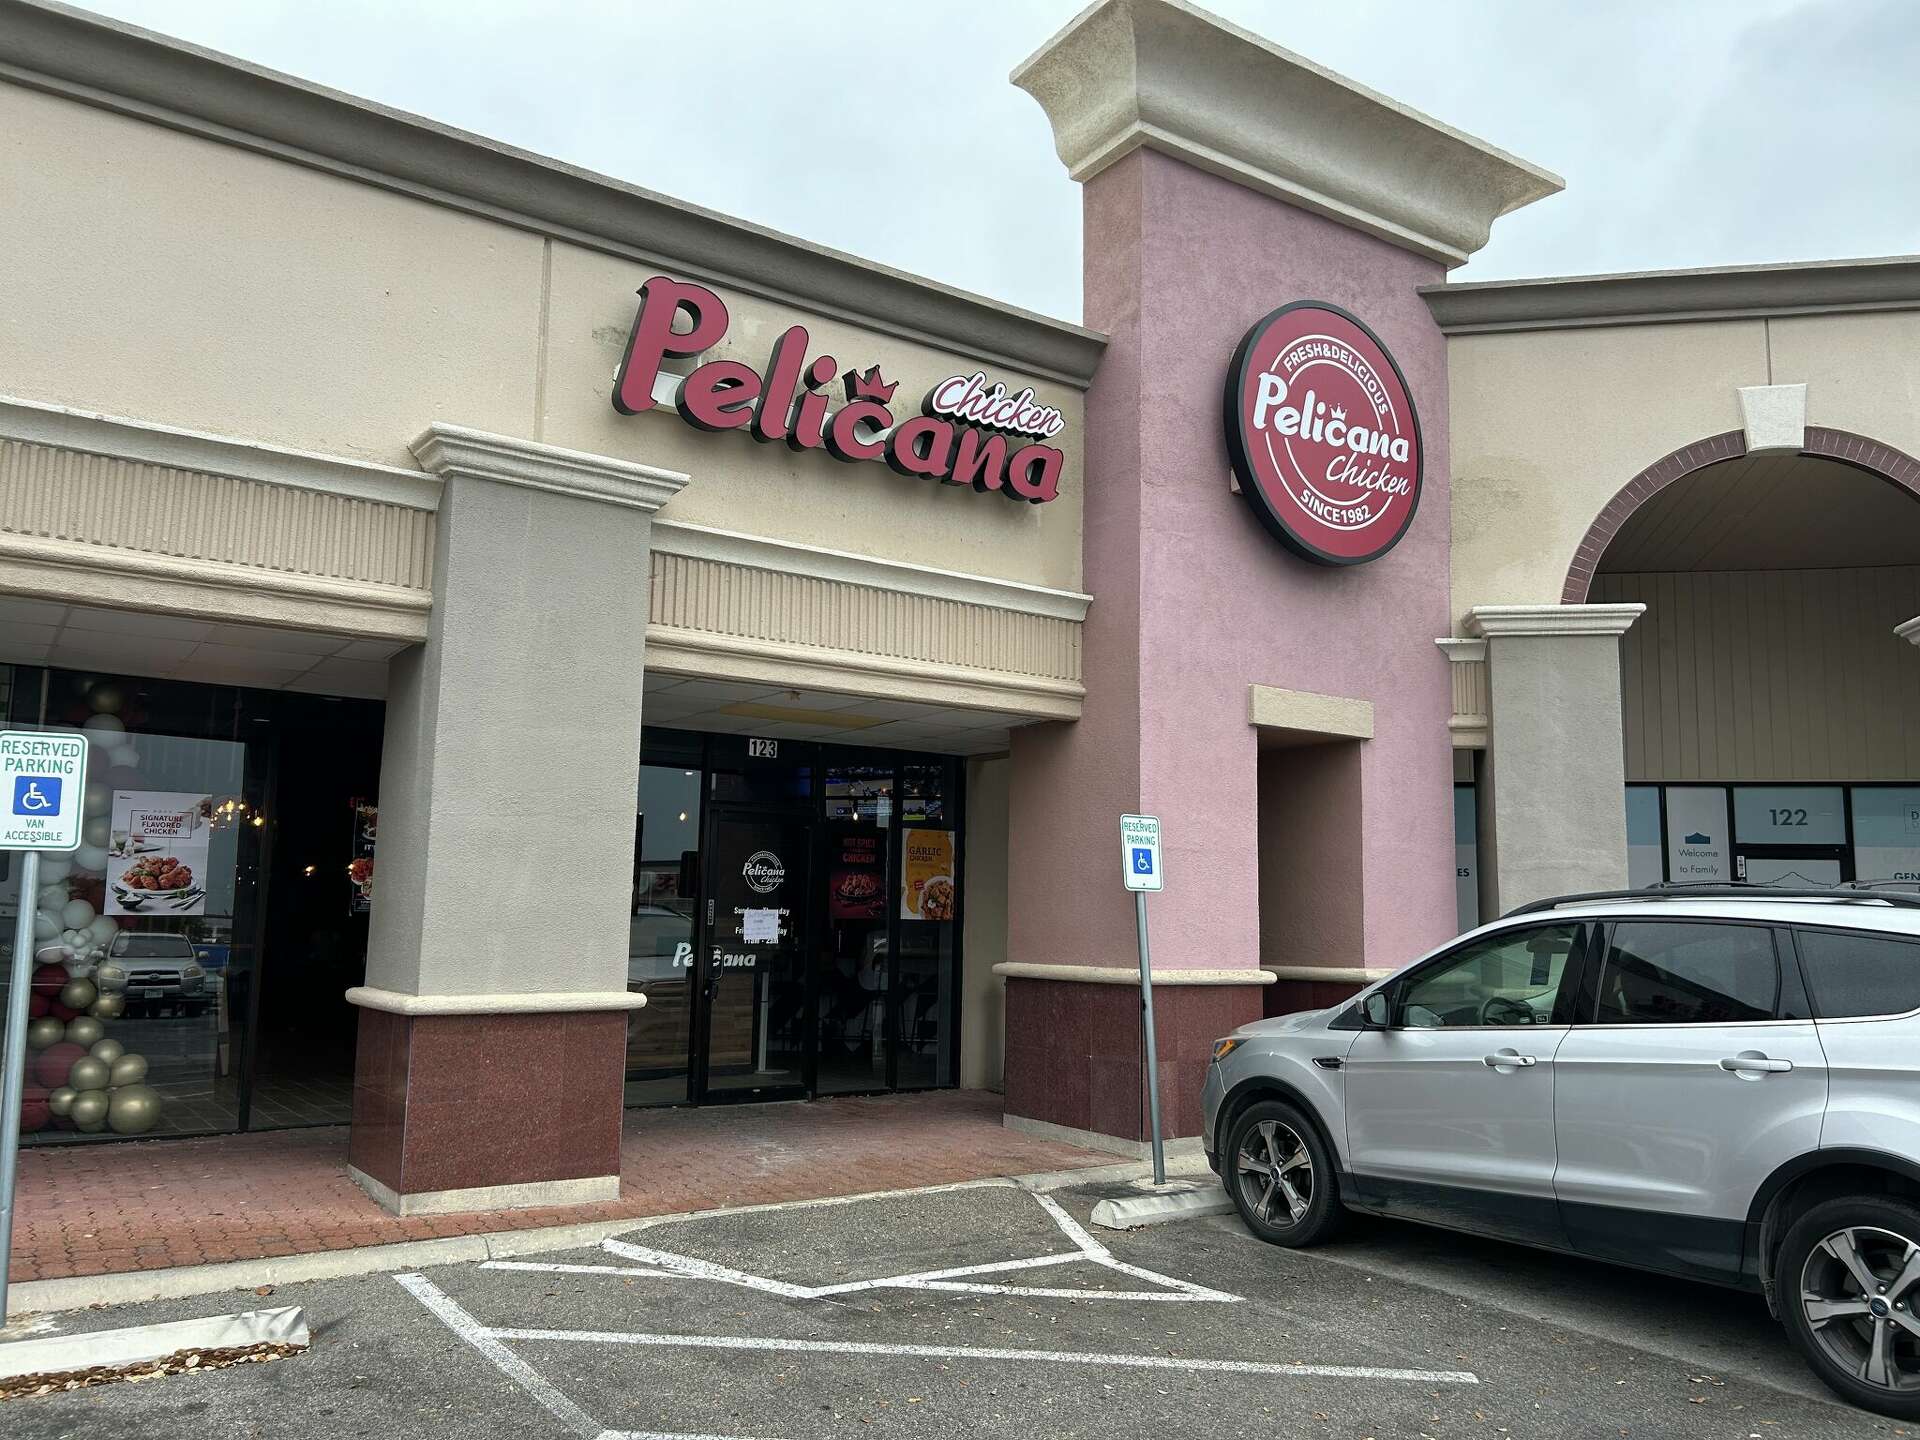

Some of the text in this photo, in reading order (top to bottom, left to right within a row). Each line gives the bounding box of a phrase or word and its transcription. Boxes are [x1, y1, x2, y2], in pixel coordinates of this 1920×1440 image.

[1283, 343, 1389, 415] FRESH&DELICIOUS
[613, 276, 1065, 504] Pelicana
[923, 371, 1065, 438] Chicken
[1253, 371, 1409, 463] Pelicana
[1326, 455, 1410, 496] Chicken
[1, 740, 80, 757] RESERVED
[752, 740, 776, 756] 123
[5, 758, 73, 774] PARKING
[140, 814, 183, 822] SIGNATURE
[1769, 808, 1808, 825] 122
[26, 819, 44, 828] VAN
[142, 821, 181, 829] FLAVORED
[1124, 822, 1157, 833] RESERVED
[4, 831, 62, 841] ACCESSIBLE
[1127, 835, 1156, 846] PARKING
[842, 852, 876, 863] CHICKEN
[909, 846, 942, 857] GARLIC
[1678, 848, 1718, 857] Welcome
[742, 862, 785, 875] Pelicana
[1680, 864, 1719, 876] to Family
[672, 942, 757, 968] Pecana
